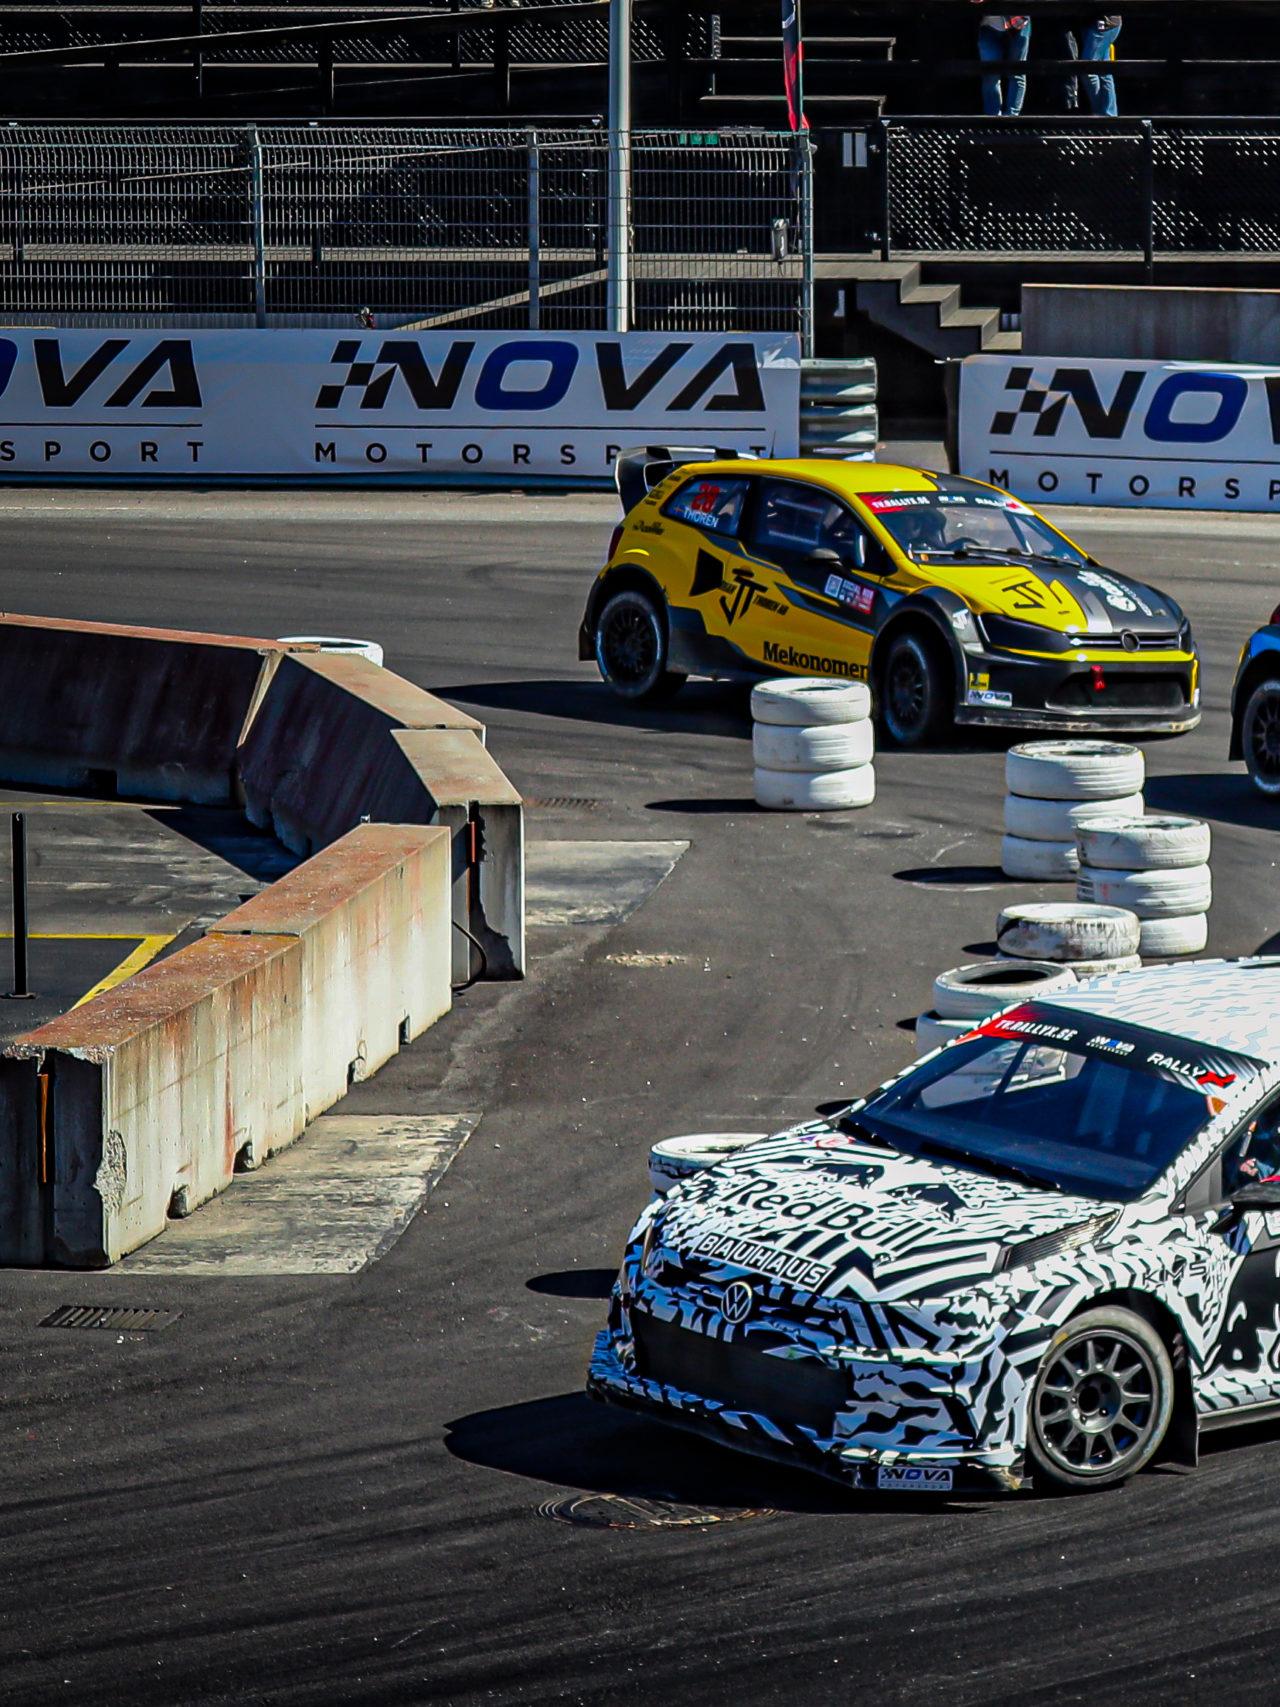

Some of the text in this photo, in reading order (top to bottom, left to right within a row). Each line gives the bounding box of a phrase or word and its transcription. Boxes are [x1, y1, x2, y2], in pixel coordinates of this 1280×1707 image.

[314, 340, 766, 411] NOVA
[995, 1019, 1079, 1042] TV.RALLYX.SE
[720, 1178, 938, 1252] Red Bull
[701, 1233, 828, 1286] BAUHAUS
[880, 1468, 950, 1481] NOVA
